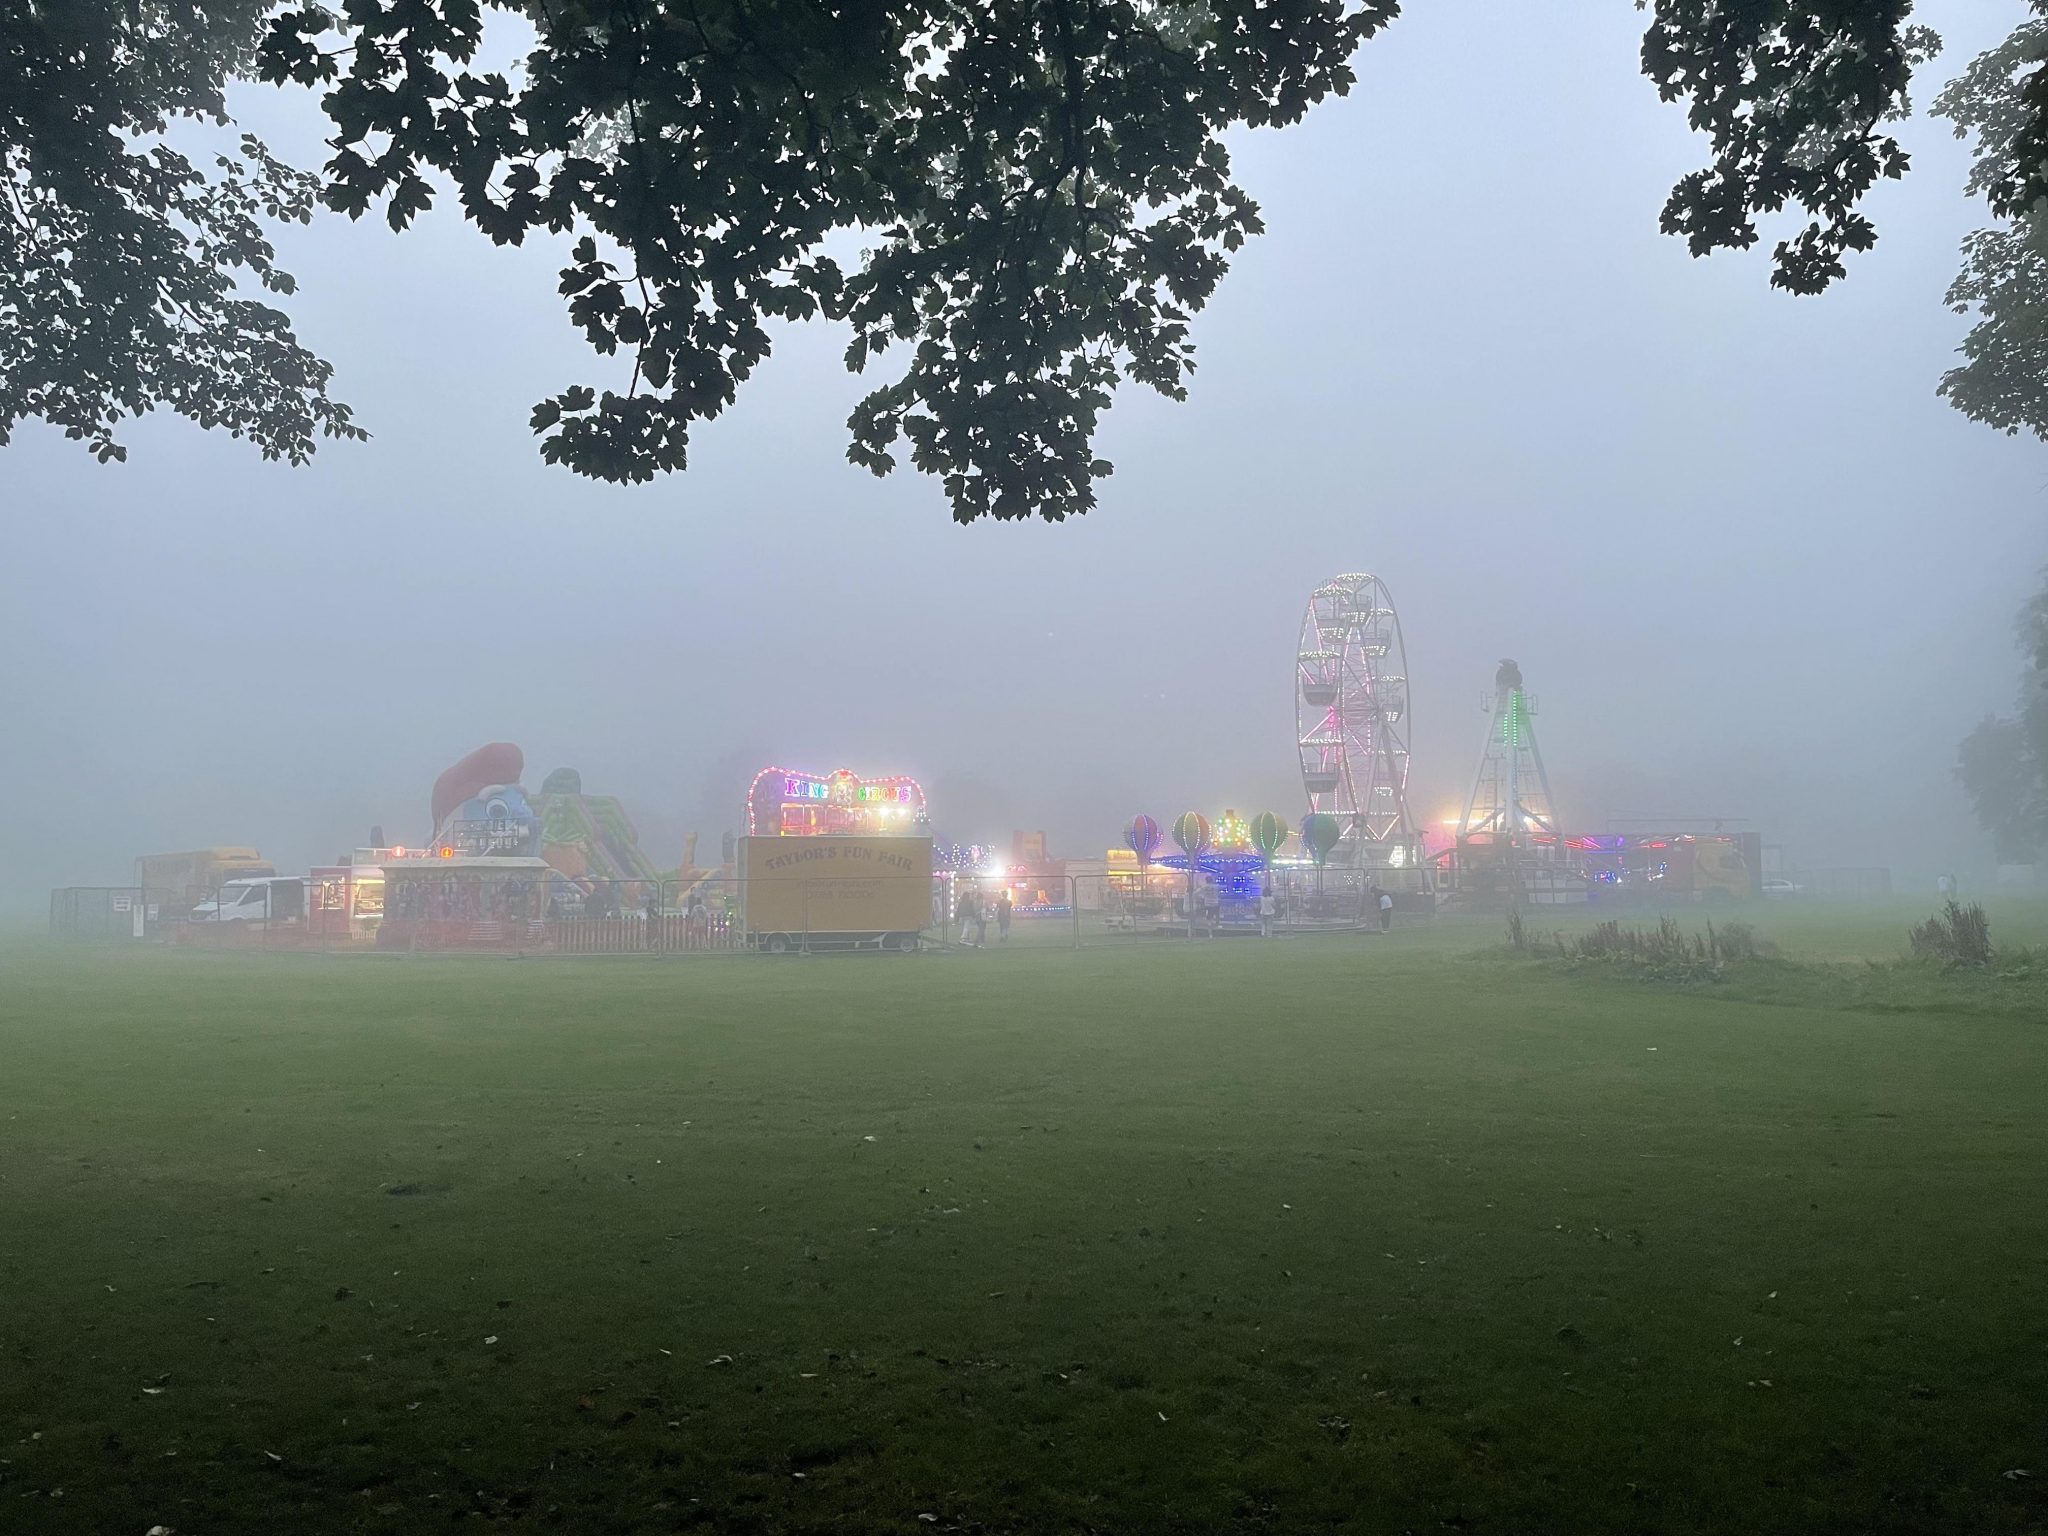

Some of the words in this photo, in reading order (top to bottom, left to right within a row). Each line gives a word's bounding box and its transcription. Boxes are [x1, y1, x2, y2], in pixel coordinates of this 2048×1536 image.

[785, 778, 829, 798] KING
[858, 786, 911, 802] CIRCUS
[766, 846, 837, 870] TAYLOR'S
[843, 846, 872, 860] FUN
[878, 851, 912, 871] FAIR
